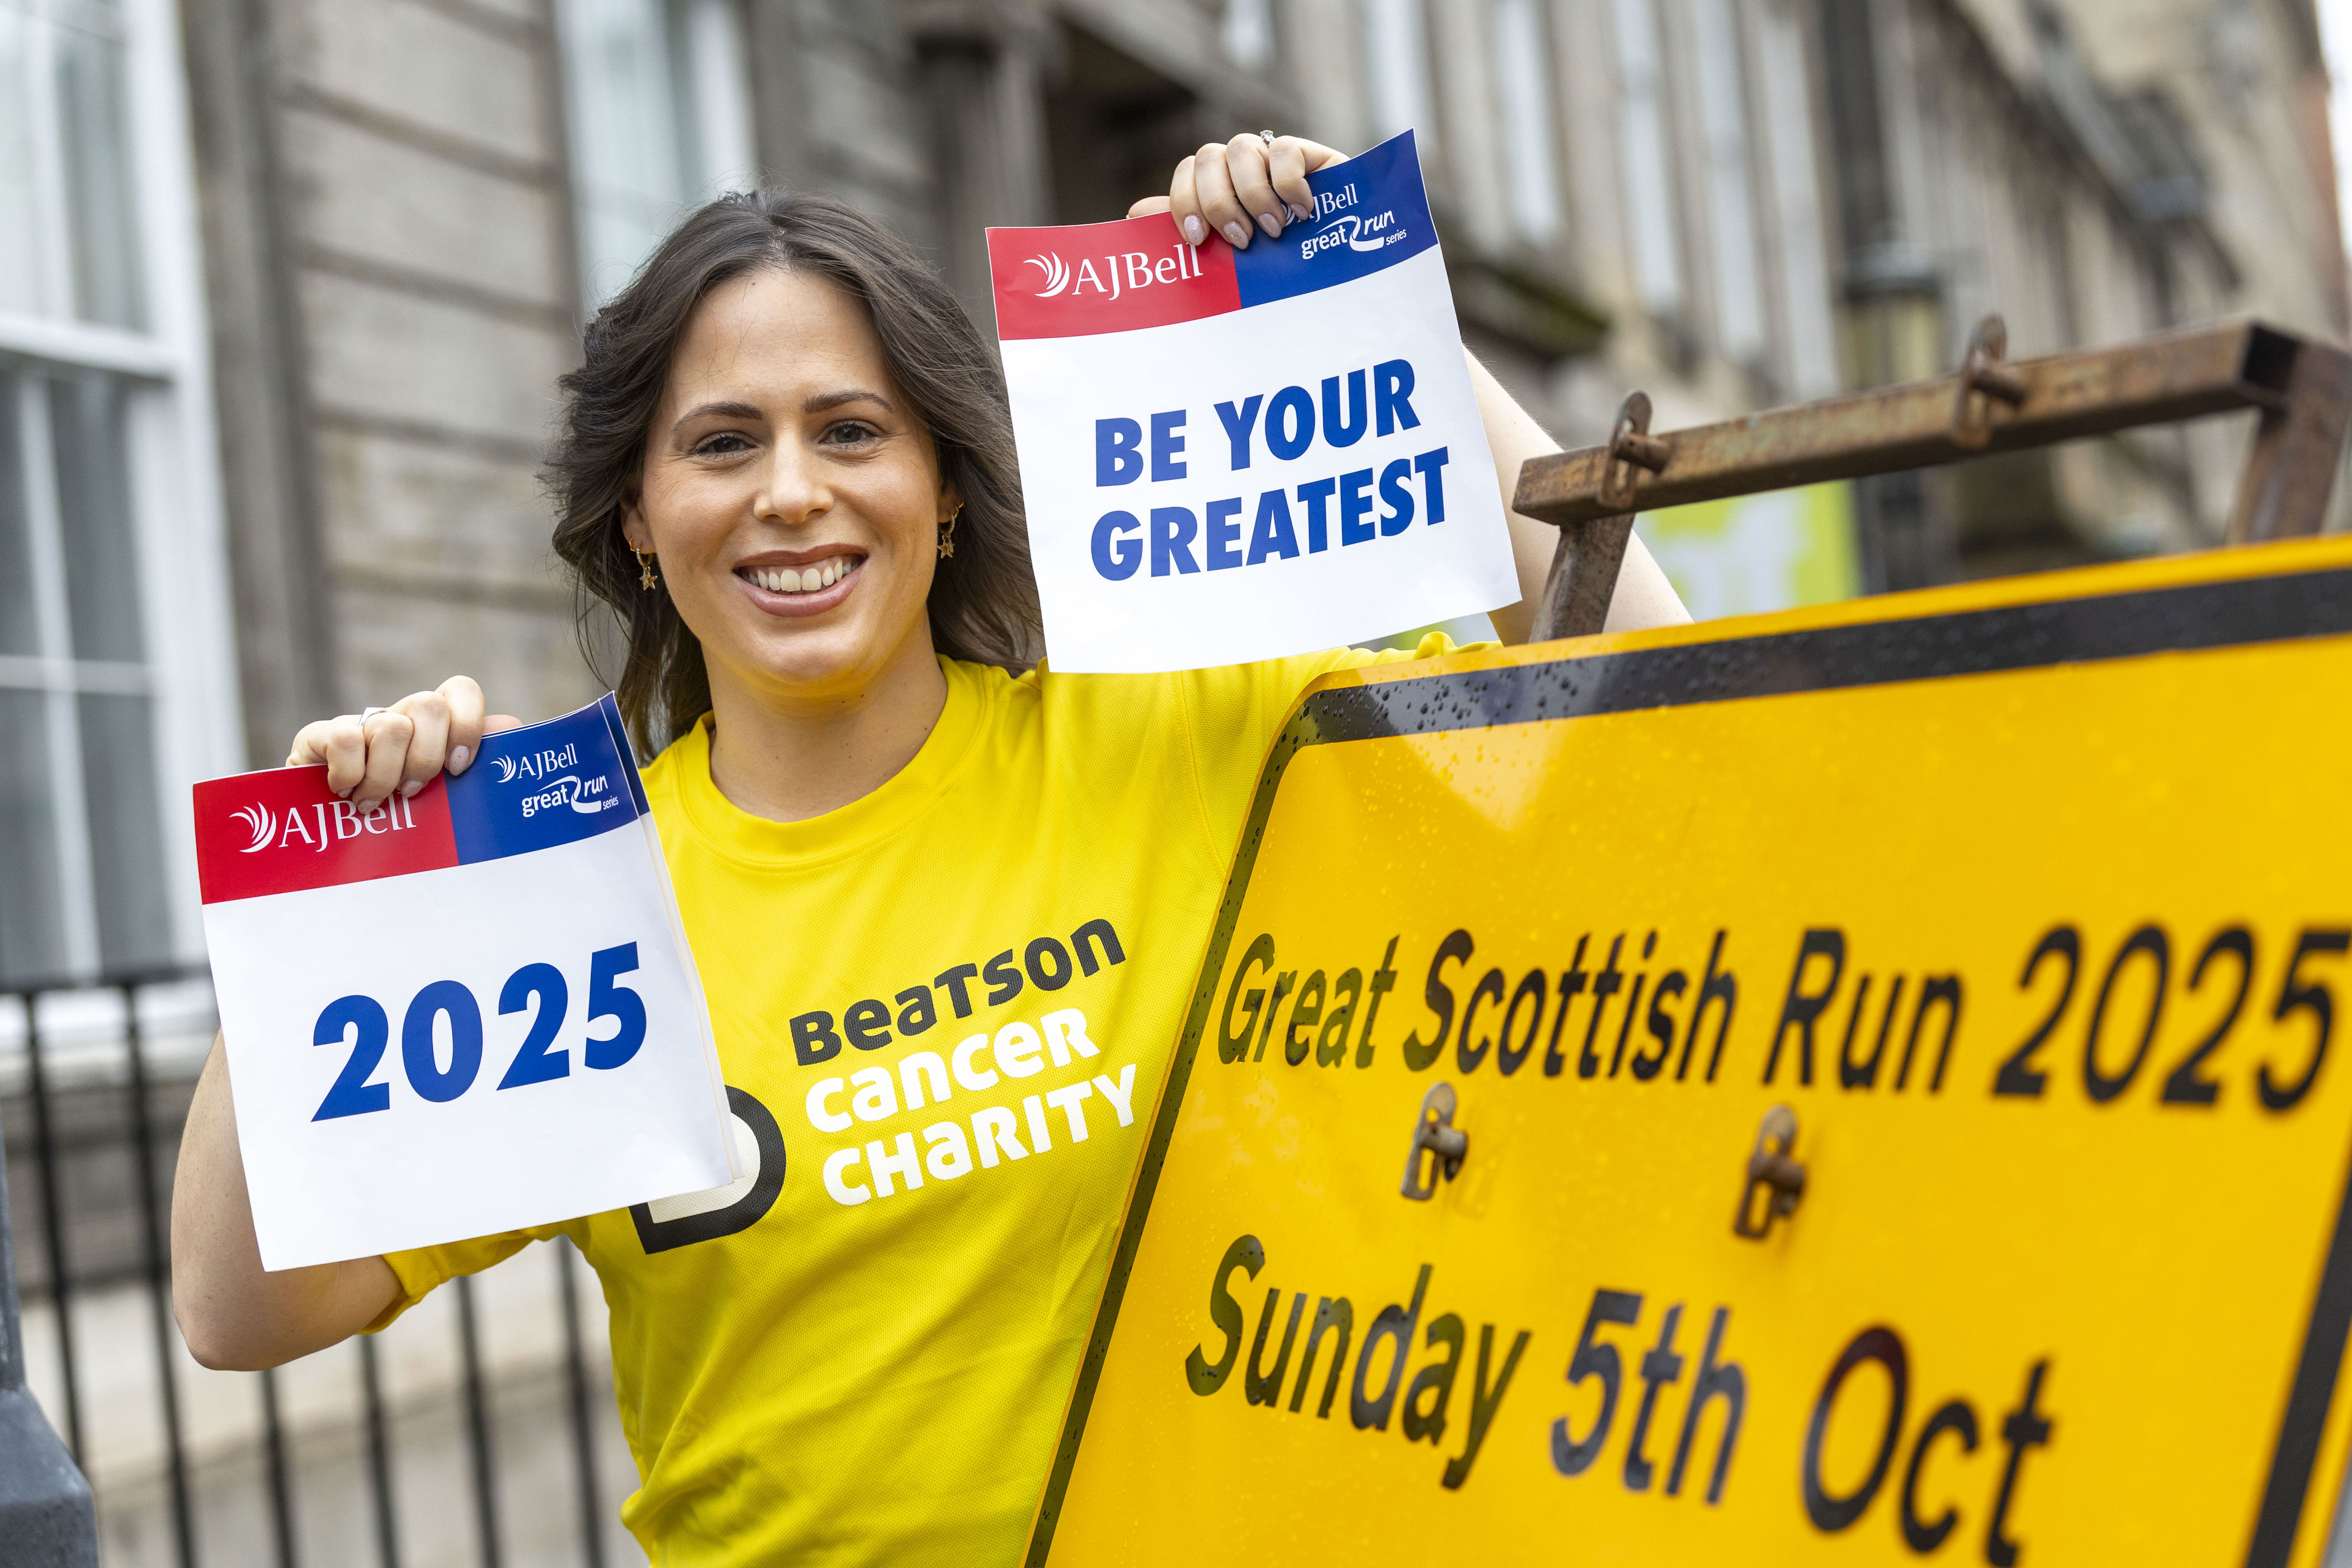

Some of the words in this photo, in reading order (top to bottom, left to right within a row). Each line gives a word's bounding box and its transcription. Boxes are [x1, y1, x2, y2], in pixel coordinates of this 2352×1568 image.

[1297, 183, 1359, 223] JBell
[1301, 225, 1348, 259] great
[1364, 210, 1395, 235] run
[1386, 229, 1407, 245] series
[1095, 409, 1187, 487] BE
[1213, 359, 1420, 471] YOUR
[1090, 446, 1449, 581] GREATEST
[522, 785, 569, 818] great
[584, 775, 608, 797] run
[603, 795, 619, 810] series
[311, 941, 647, 1122] 2025
[1217, 933, 1400, 1069] Great
[1402, 927, 1737, 1084] Scottish
[1762, 927, 1963, 1094] Run
[1991, 923, 2352, 1113] 2025
[1185, 1234, 1532, 1491] Sunday
[1549, 1285, 1748, 1507] 5th
[1801, 1321, 2056, 1568] Oct
